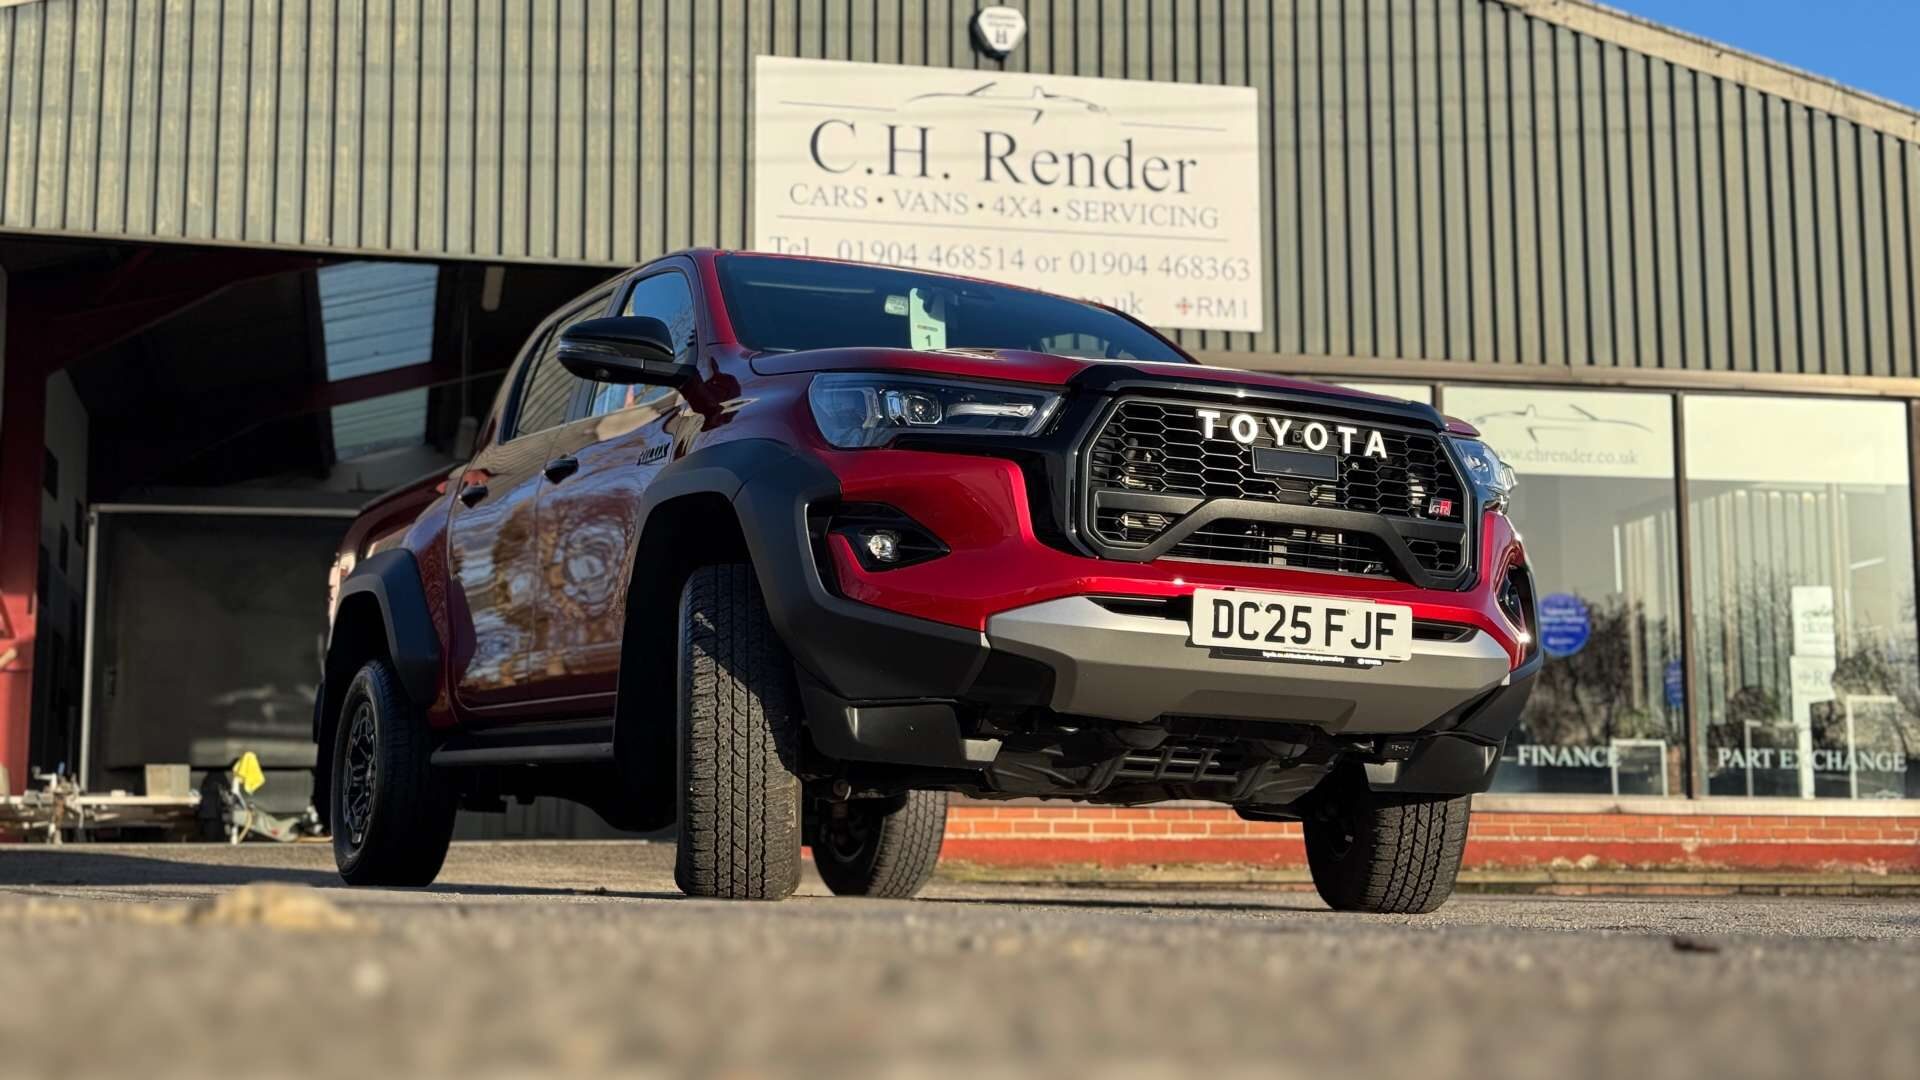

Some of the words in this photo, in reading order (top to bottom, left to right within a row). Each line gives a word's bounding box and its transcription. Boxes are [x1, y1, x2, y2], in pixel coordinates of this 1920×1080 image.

[809, 118, 950, 179] C.H.
[976, 129, 1198, 194] Render
[789, 182, 868, 208] CARS
[893, 189, 969, 215] VANS
[991, 195, 1043, 218] 4X4
[1066, 199, 1220, 229] SERVICING
[837, 238, 918, 266] 01904
[927, 244, 1024, 271] 468514
[1035, 254, 1061, 273] or
[1069, 250, 1148, 276] 01904
[1157, 254, 1251, 282] 468363
[1196, 408, 1387, 459] TOYOTA
[1212, 599, 1312, 645] DC25
[1325, 608, 1397, 651] FJF
[1517, 745, 1621, 767] FINANCE
[1718, 747, 1775, 769] PART
[1780, 750, 1908, 772] ECHANGE
